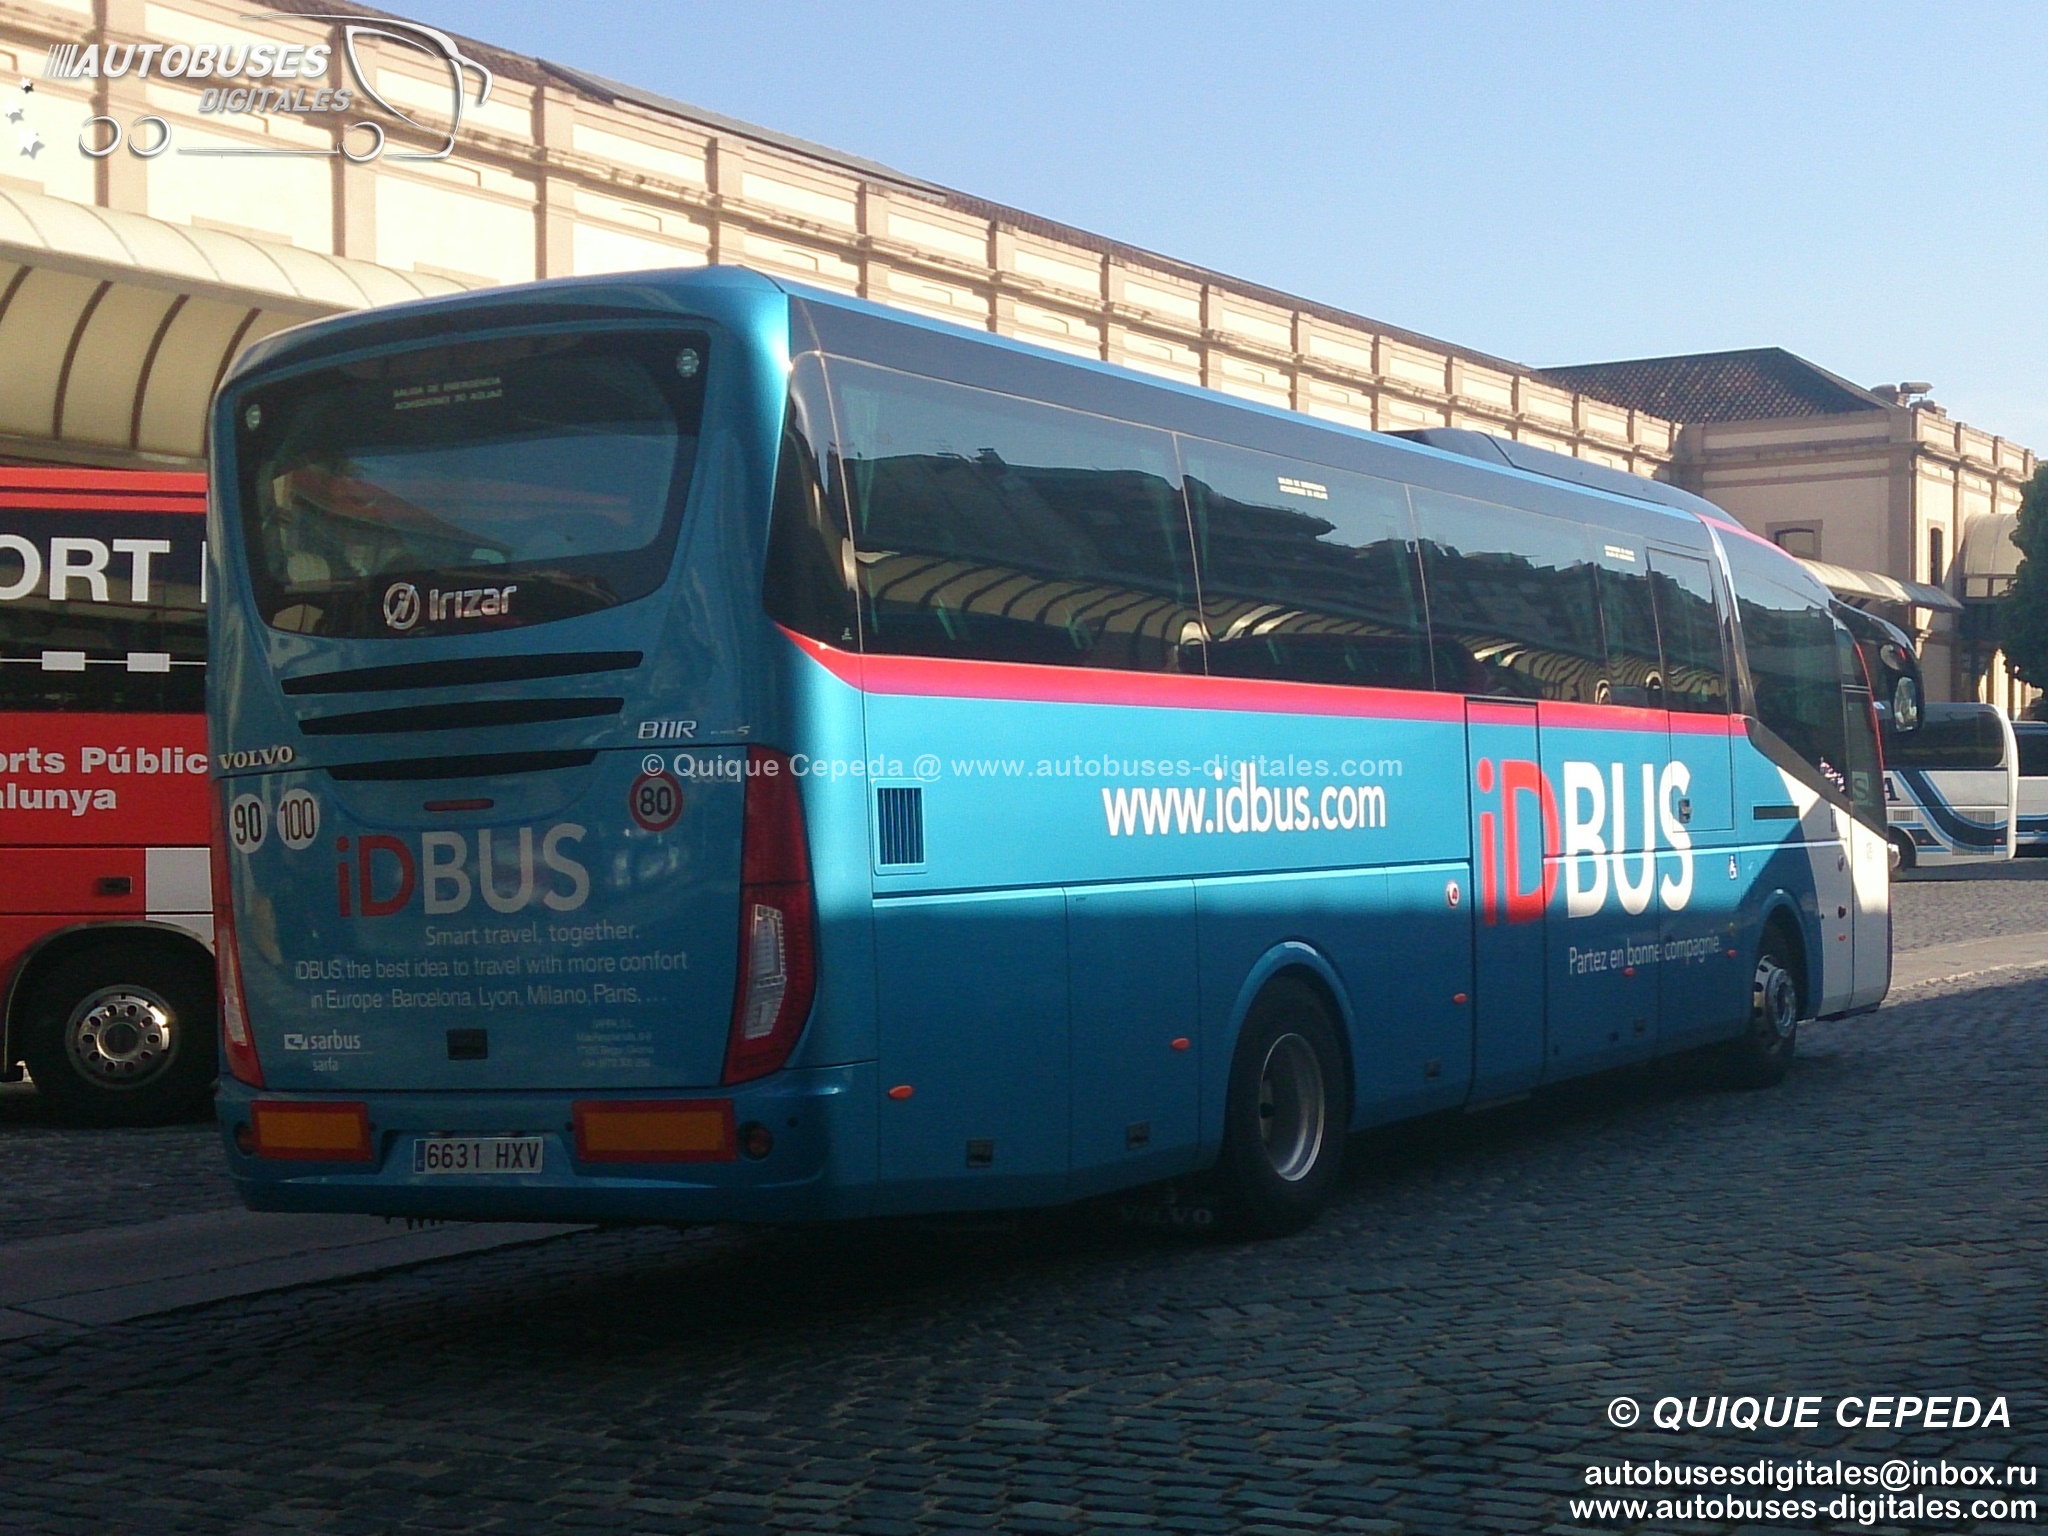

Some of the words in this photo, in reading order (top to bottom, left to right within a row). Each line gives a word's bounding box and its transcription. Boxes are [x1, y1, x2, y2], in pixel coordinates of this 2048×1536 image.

[429, 585, 518, 621] Irizar
[218, 744, 293, 770] VOLVO
[0, 782, 117, 816] lunya
[639, 785, 673, 817] 80
[1101, 761, 1387, 837] www.idbus.com
[234, 802, 263, 845] 90
[280, 796, 316, 841] 100
[1476, 757, 1694, 927] iDBUS
[335, 822, 591, 918] iDBUS
[425, 925, 480, 946] Smart
[484, 921, 542, 946] travel,
[548, 918, 640, 948] together.
[346, 959, 372, 979] the
[375, 957, 410, 978] best
[414, 957, 449, 977] idea
[452, 958, 469, 976] to
[473, 954, 521, 976] travel
[526, 954, 562, 974] with
[567, 955, 616, 973] more
[619, 950, 688, 972] confort
[1568, 946, 1608, 976] Partez
[1610, 948, 1624, 970] en
[1626, 937, 1661, 966] bonne
[310, 989, 323, 1009] in
[311, 1028, 361, 1050] sarbus
[312, 1056, 339, 1072] sarfa
[426, 1142, 481, 1170] 6631
[495, 1142, 540, 1169] HXV
